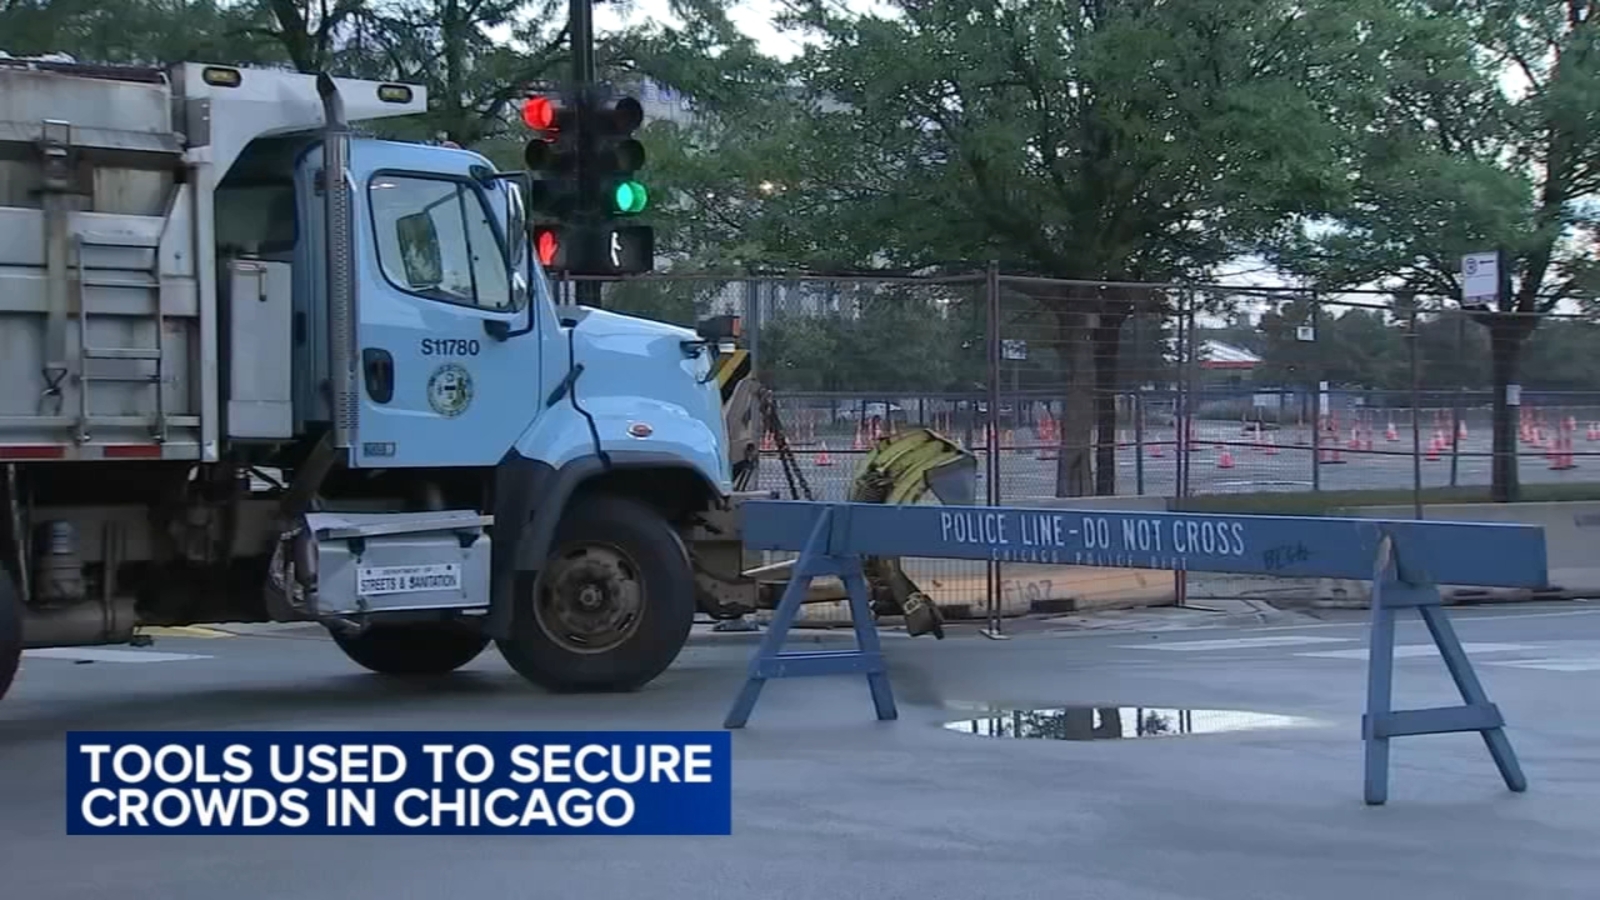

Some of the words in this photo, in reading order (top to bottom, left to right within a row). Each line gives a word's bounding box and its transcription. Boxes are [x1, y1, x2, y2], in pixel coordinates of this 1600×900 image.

[421, 338, 480, 356] S11780
[941, 512, 1008, 544] POLICE
[1123, 517, 1162, 552] NOT
[1173, 520, 1245, 556] CROSS
[992, 548, 1059, 563] CHICAGO
[1076, 552, 1134, 567] POLICE
[361, 577, 396, 592] STREETS
[409, 574, 457, 589] SANITATION
